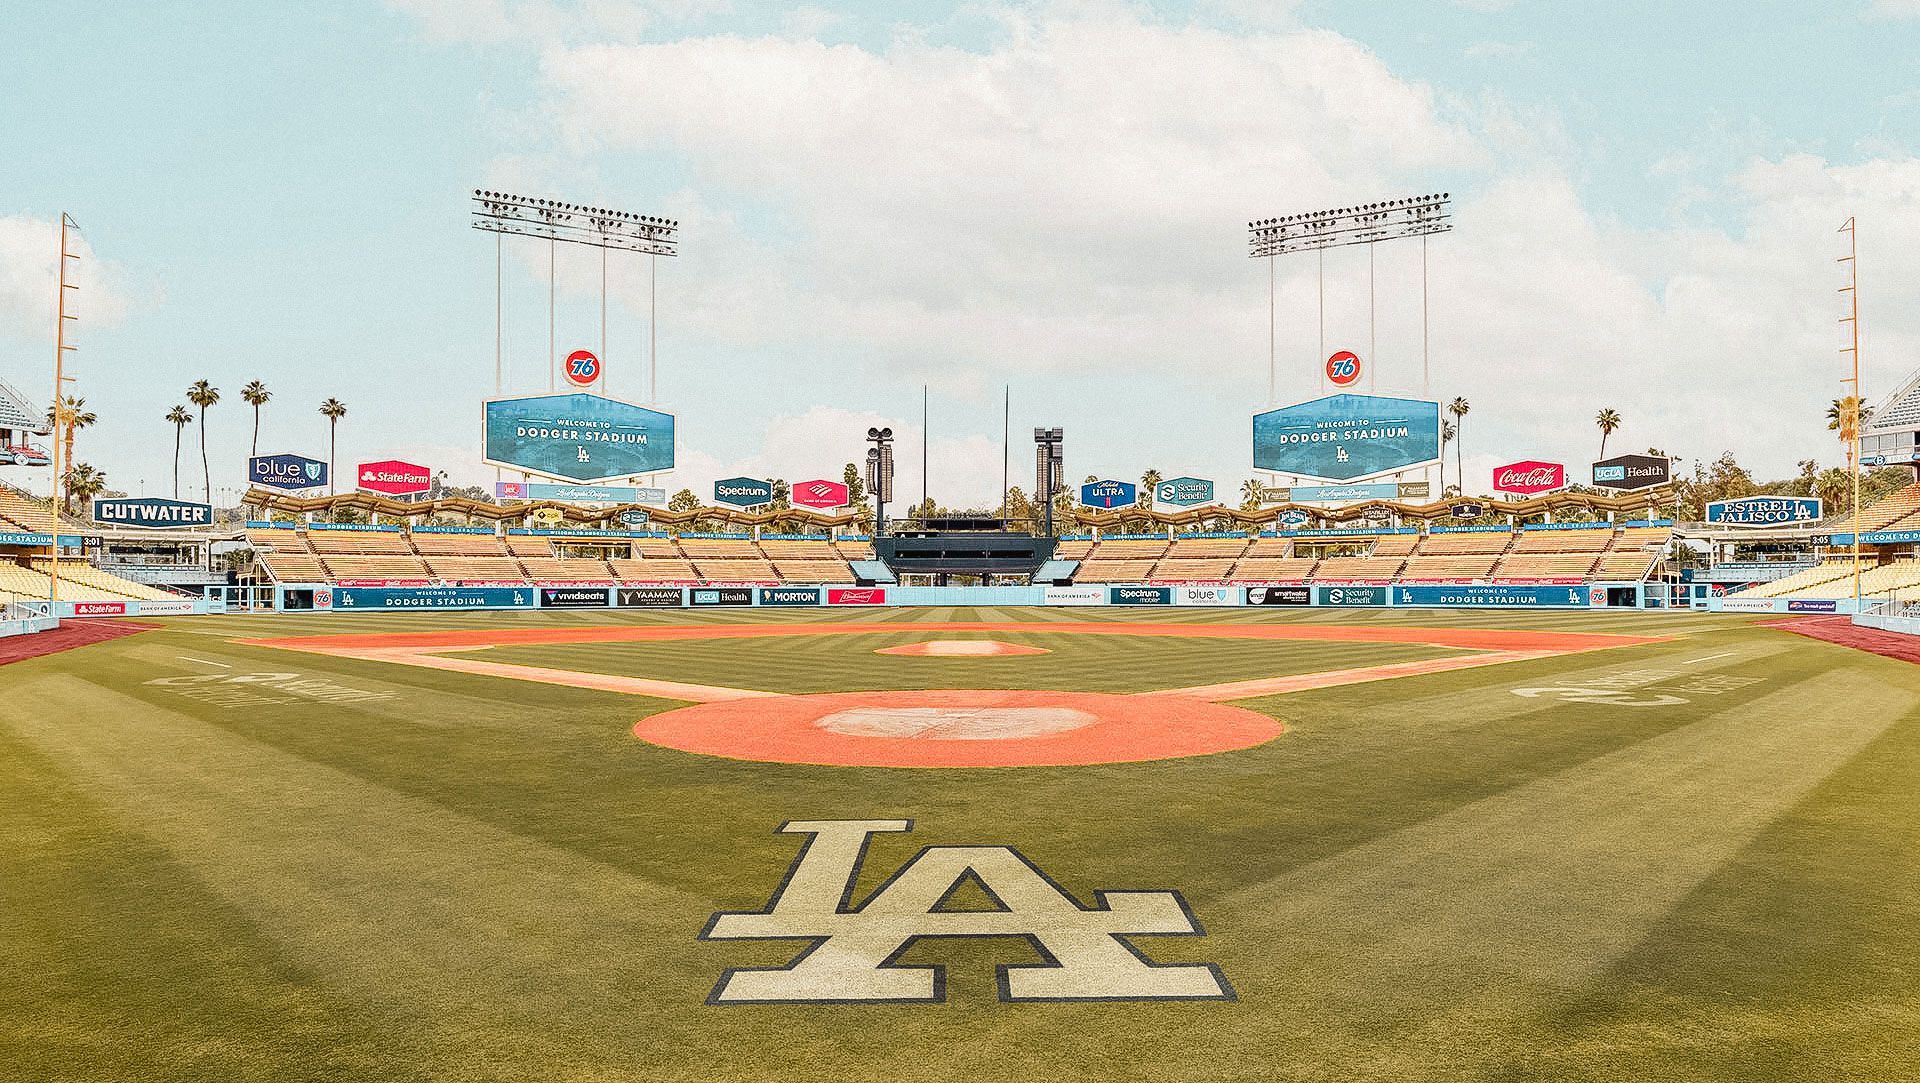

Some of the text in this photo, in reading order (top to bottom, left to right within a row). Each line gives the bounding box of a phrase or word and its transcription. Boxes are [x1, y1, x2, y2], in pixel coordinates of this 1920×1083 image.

[572, 358, 595, 377] 76
[1331, 358, 1355, 378] 76
[556, 418, 611, 429] WELCOME TO
[1316, 419, 1370, 429] WELCOME TO
[517, 426, 648, 445] DODGER STADIUM
[1279, 426, 1409, 445] DODGER STADIUM
[577, 445, 590, 463] LA
[1336, 445, 1349, 463] LA
[256, 458, 301, 477] blue
[1596, 465, 1664, 479] UCLA Health
[262, 475, 306, 485] california
[1498, 466, 1558, 489] Coca-Cola
[718, 484, 764, 497] Spectrum
[1092, 487, 1125, 497] ULTRA
[1177, 482, 1209, 493] Security
[1178, 491, 1205, 500] Benefit
[101, 502, 205, 523] CUTWATER
[1716, 510, 1790, 523] JALISCO
[15, 535, 53, 543] STADIUM
[83, 537, 100, 546] 3:01
[1812, 536, 1829, 545] 3:05
[1858, 533, 1896, 542] WELCOME
[1899, 532, 1909, 540] TO
[317, 594, 329, 602] 76
[342, 590, 354, 606] LA
[513, 590, 524, 605] LA
[558, 591, 605, 600] vividseats
[721, 592, 747, 601] Health
[774, 592, 816, 602] MORTON
[1120, 589, 1157, 599] Spectrum
[1188, 588, 1214, 600] blue
[1345, 588, 1374, 598] Security
[1401, 589, 1413, 603] LA
[1568, 588, 1581, 604] LA
[1592, 591, 1605, 600] 76
[385, 597, 485, 606] DODGER STADIUM
[1346, 596, 1370, 604] Benefit
[1440, 595, 1537, 604] DODGER STADIUM
[697, 819, 1238, 1005] LA
